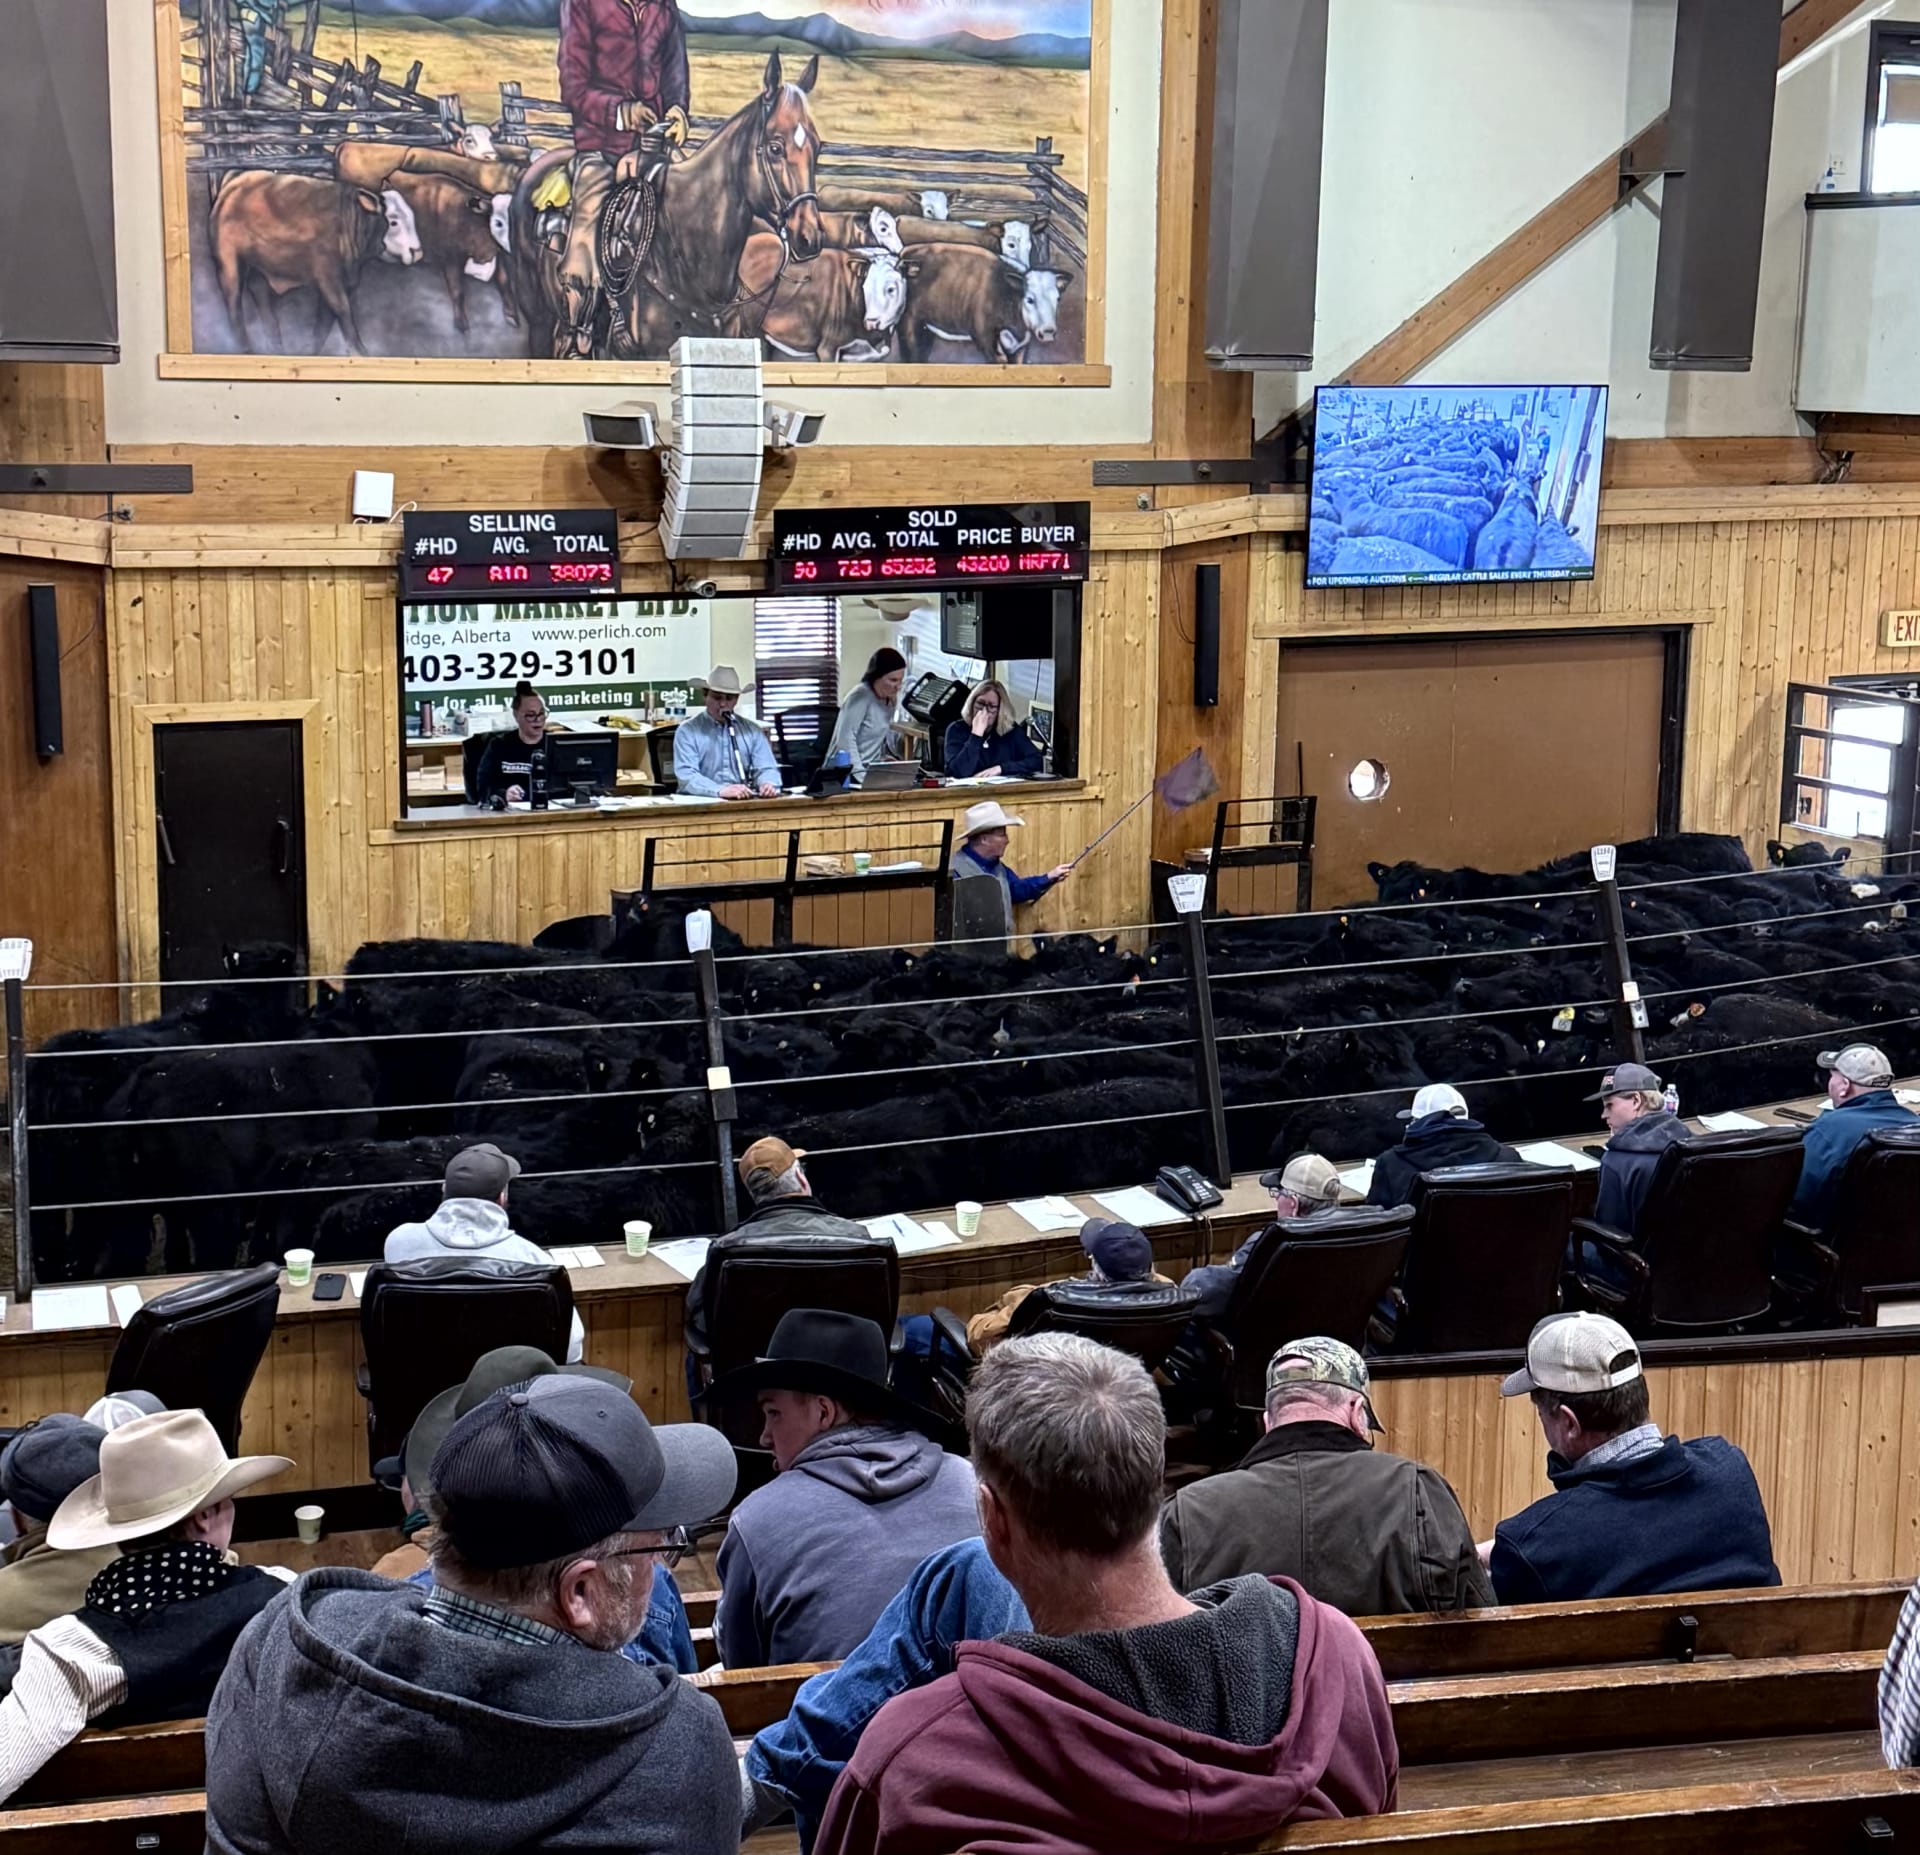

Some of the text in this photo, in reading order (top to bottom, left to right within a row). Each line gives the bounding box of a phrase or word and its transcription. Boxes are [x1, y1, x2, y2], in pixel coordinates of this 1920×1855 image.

[469, 514, 556, 533] SELLING
[908, 510, 957, 528] SOLD
[414, 535, 610, 556] #HD AVG. TOTAL
[782, 526, 1075, 550] #HD AVG. TOTAL PRICE BUYER
[427, 567, 454, 583] 47
[550, 563, 612, 582] 38073
[451, 629, 511, 645] Alberta
[531, 623, 667, 644] www.perlich.com
[1895, 615, 1920, 642] EXI
[403, 647, 636, 684] 403-329-3101
[548, 690, 633, 706] marketing
